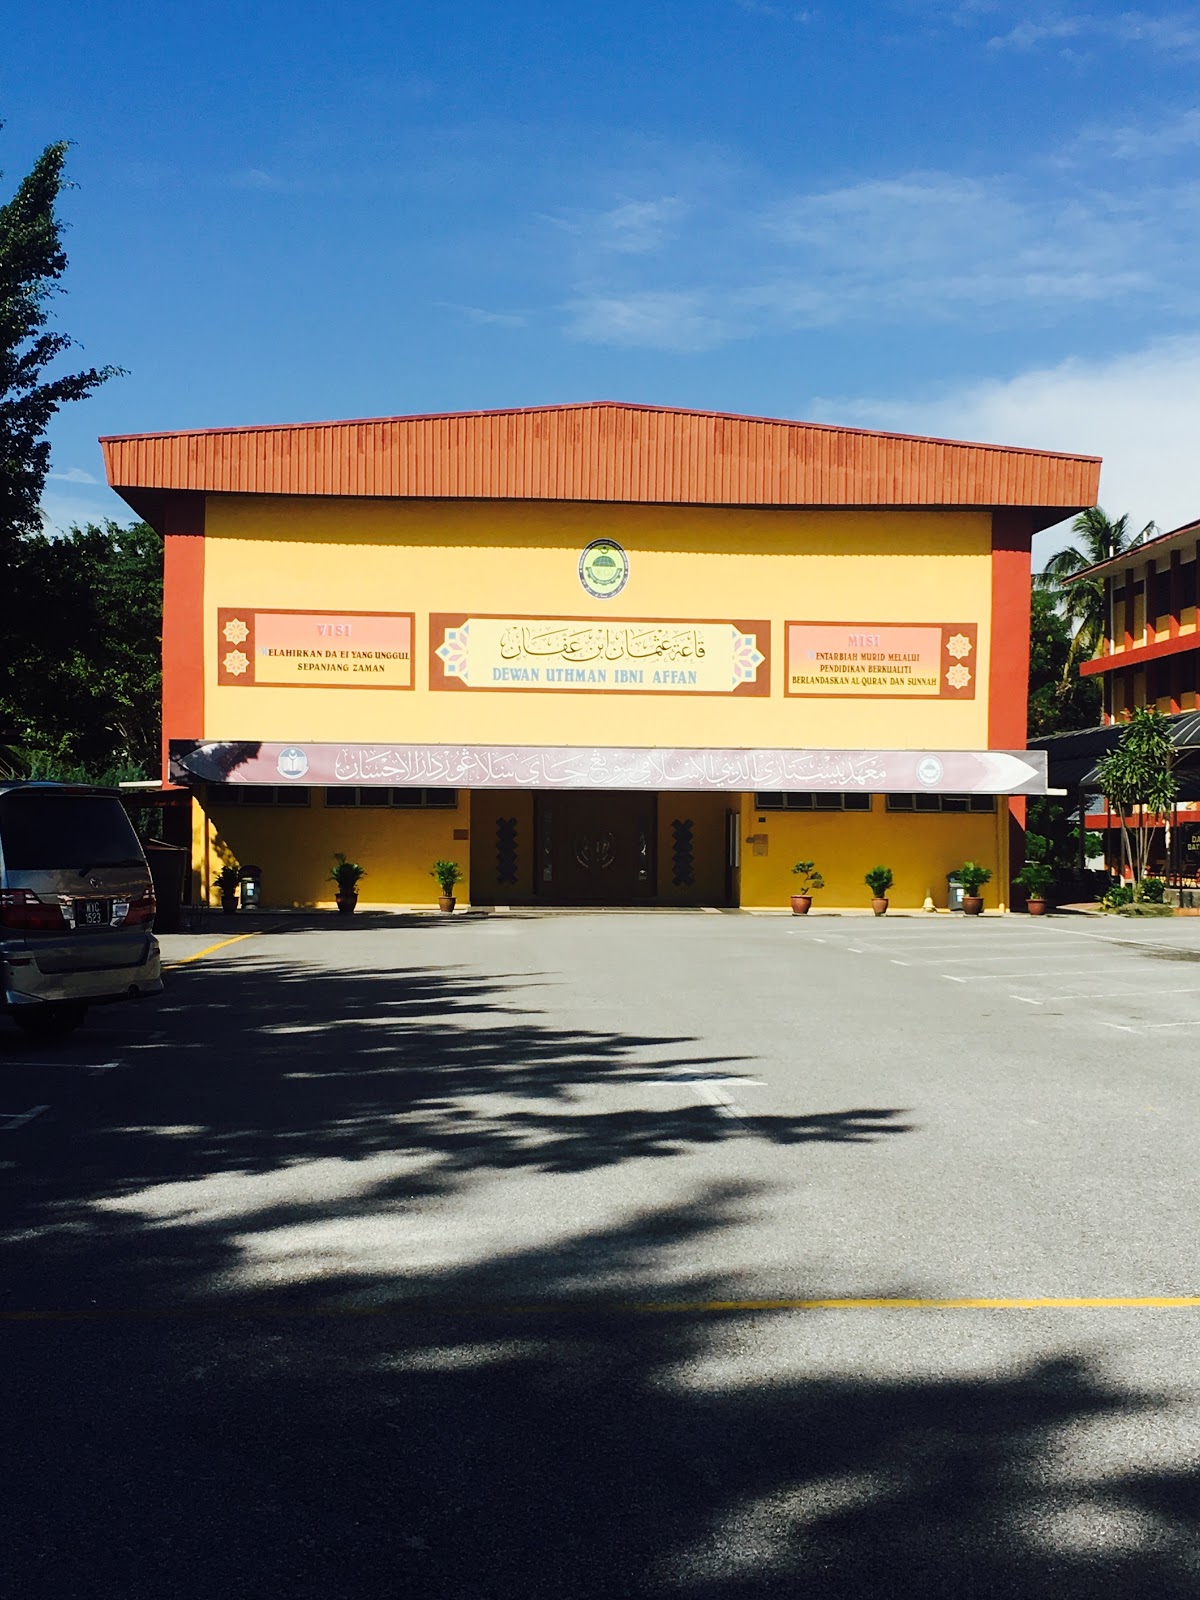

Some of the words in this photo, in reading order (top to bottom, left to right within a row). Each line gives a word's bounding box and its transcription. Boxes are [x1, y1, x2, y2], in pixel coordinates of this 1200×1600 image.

[317, 623, 352, 637] VISI
[848, 634, 880, 647] MISI
[351, 651, 373, 659] YANG
[375, 651, 410, 660] UNGGUL
[860, 653, 885, 661] MURID
[888, 653, 920, 662] MELALUI
[298, 662, 349, 672] SEPANJANG
[352, 664, 385, 672] ZAMAN
[820, 664, 866, 673] PENDIDIKAN
[868, 665, 912, 674] BERKUALITI
[493, 667, 539, 681] DEWAN
[546, 668, 606, 682] UTHMAN
[614, 670, 644, 683] IBNI
[652, 671, 697, 684] AFFAN
[792, 676, 849, 684] BERLANDASKAN
[907, 678, 937, 686] SUNNAH
